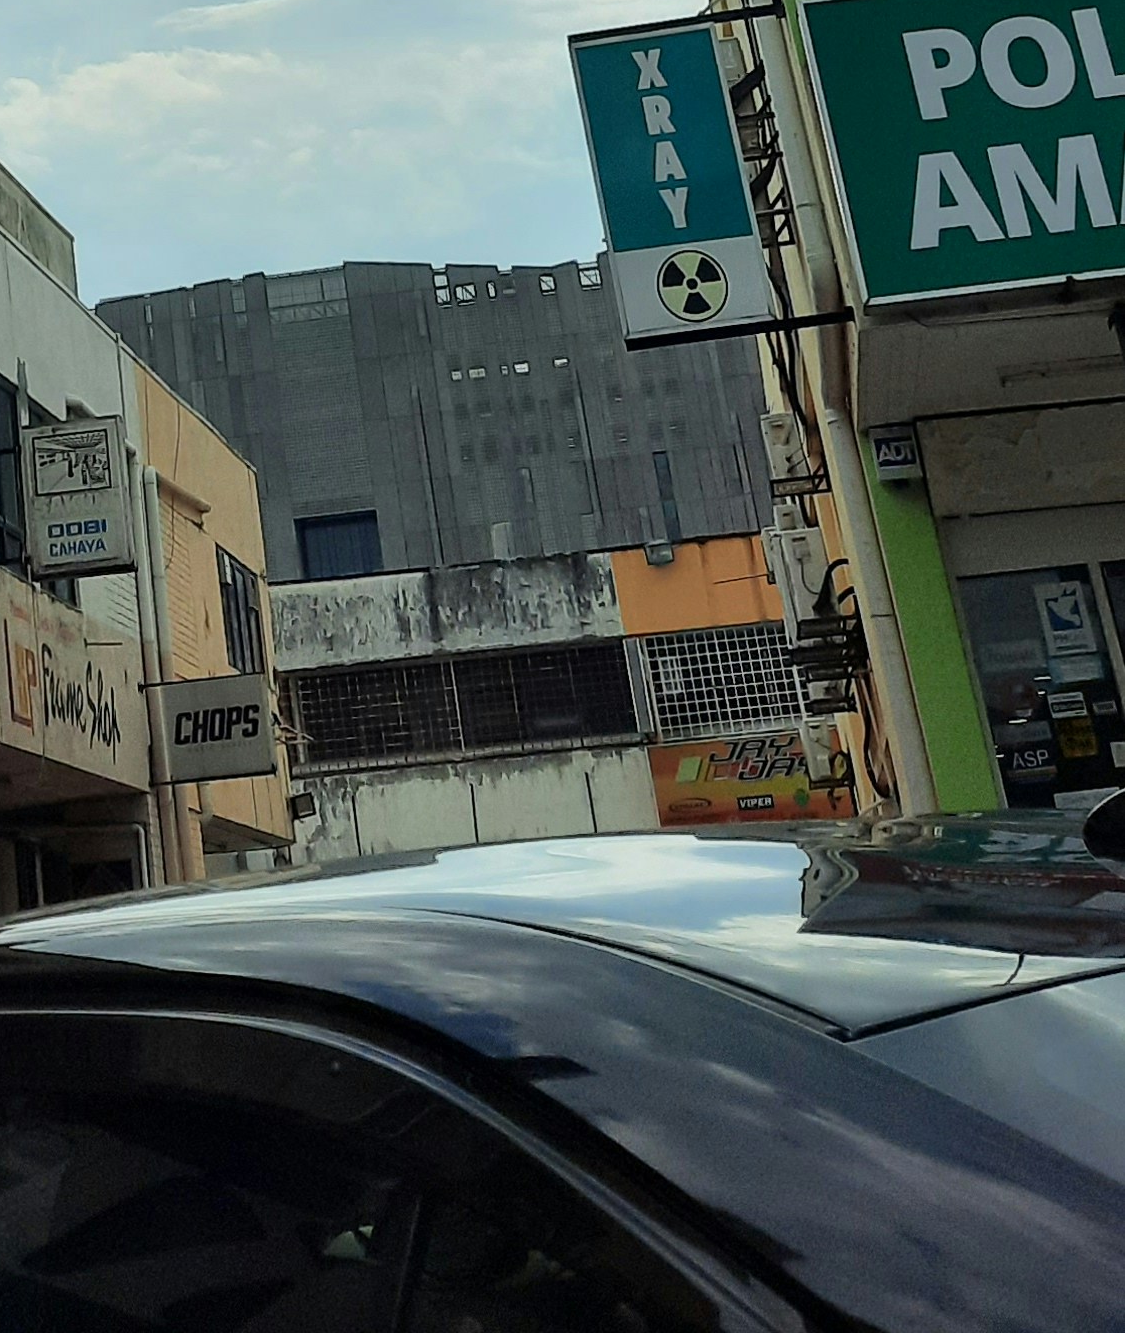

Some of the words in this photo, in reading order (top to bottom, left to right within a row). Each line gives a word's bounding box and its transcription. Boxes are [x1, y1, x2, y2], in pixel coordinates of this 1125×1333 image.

[901, 6, 1125, 121] POL
[630, 47, 690, 230] XRAY
[909, 133, 1125, 251] AM
[47, 518, 108, 540] DOBI
[49, 537, 107, 558] CAHAYA
[174, 704, 261, 746] CHOPS
[1011, 749, 1050, 770] ASP
[738, 797, 774, 810] VIPER
